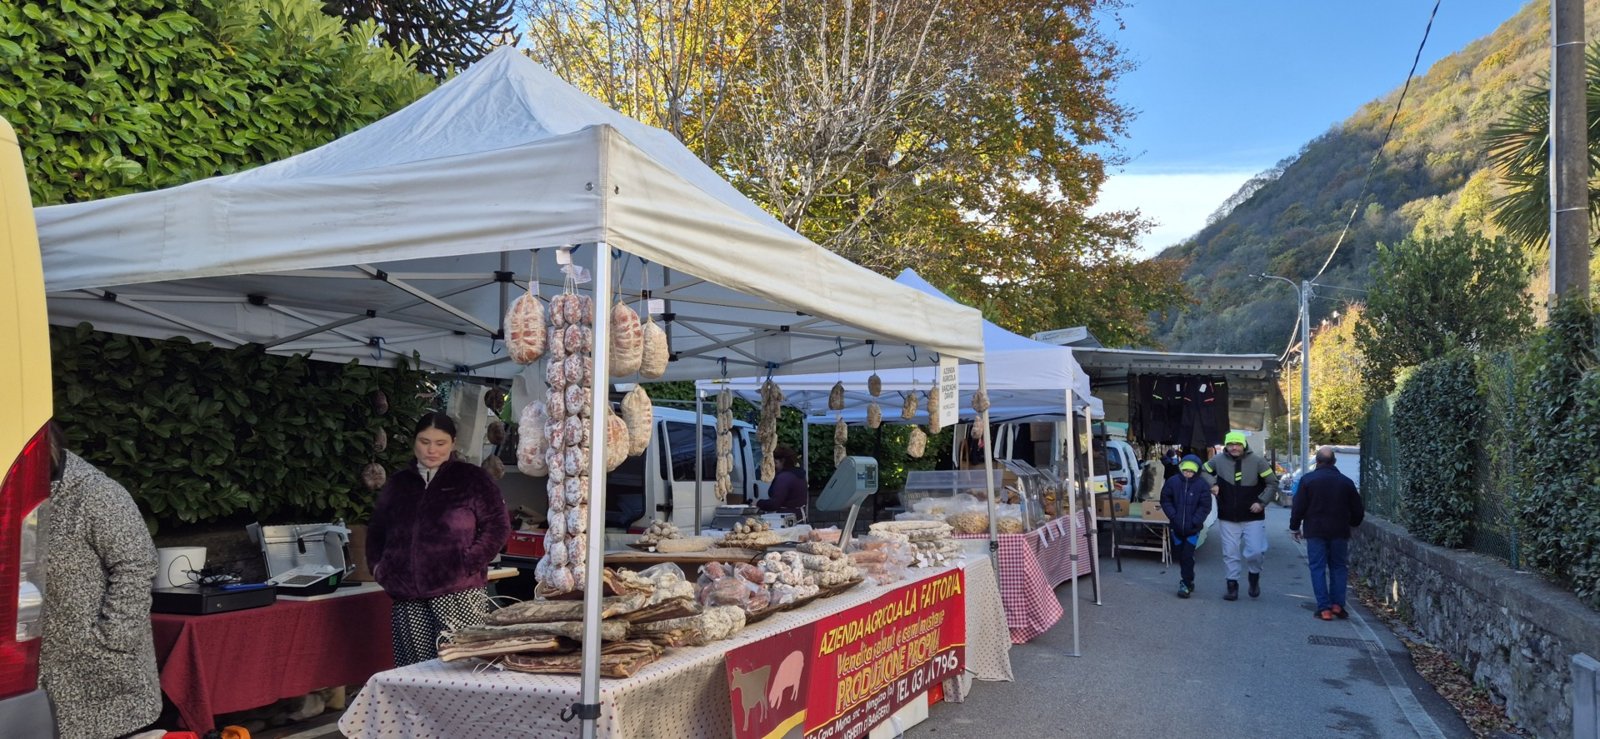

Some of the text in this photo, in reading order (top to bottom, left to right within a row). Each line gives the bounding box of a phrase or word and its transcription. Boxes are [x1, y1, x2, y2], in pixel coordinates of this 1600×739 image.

[818, 572, 961, 657] AZIENDA AGRICOLA LA FATTORIA
[836, 646, 906, 714] PRODUZIONE
[837, 641, 873, 678] Vendita
[896, 630, 902, 647] e
